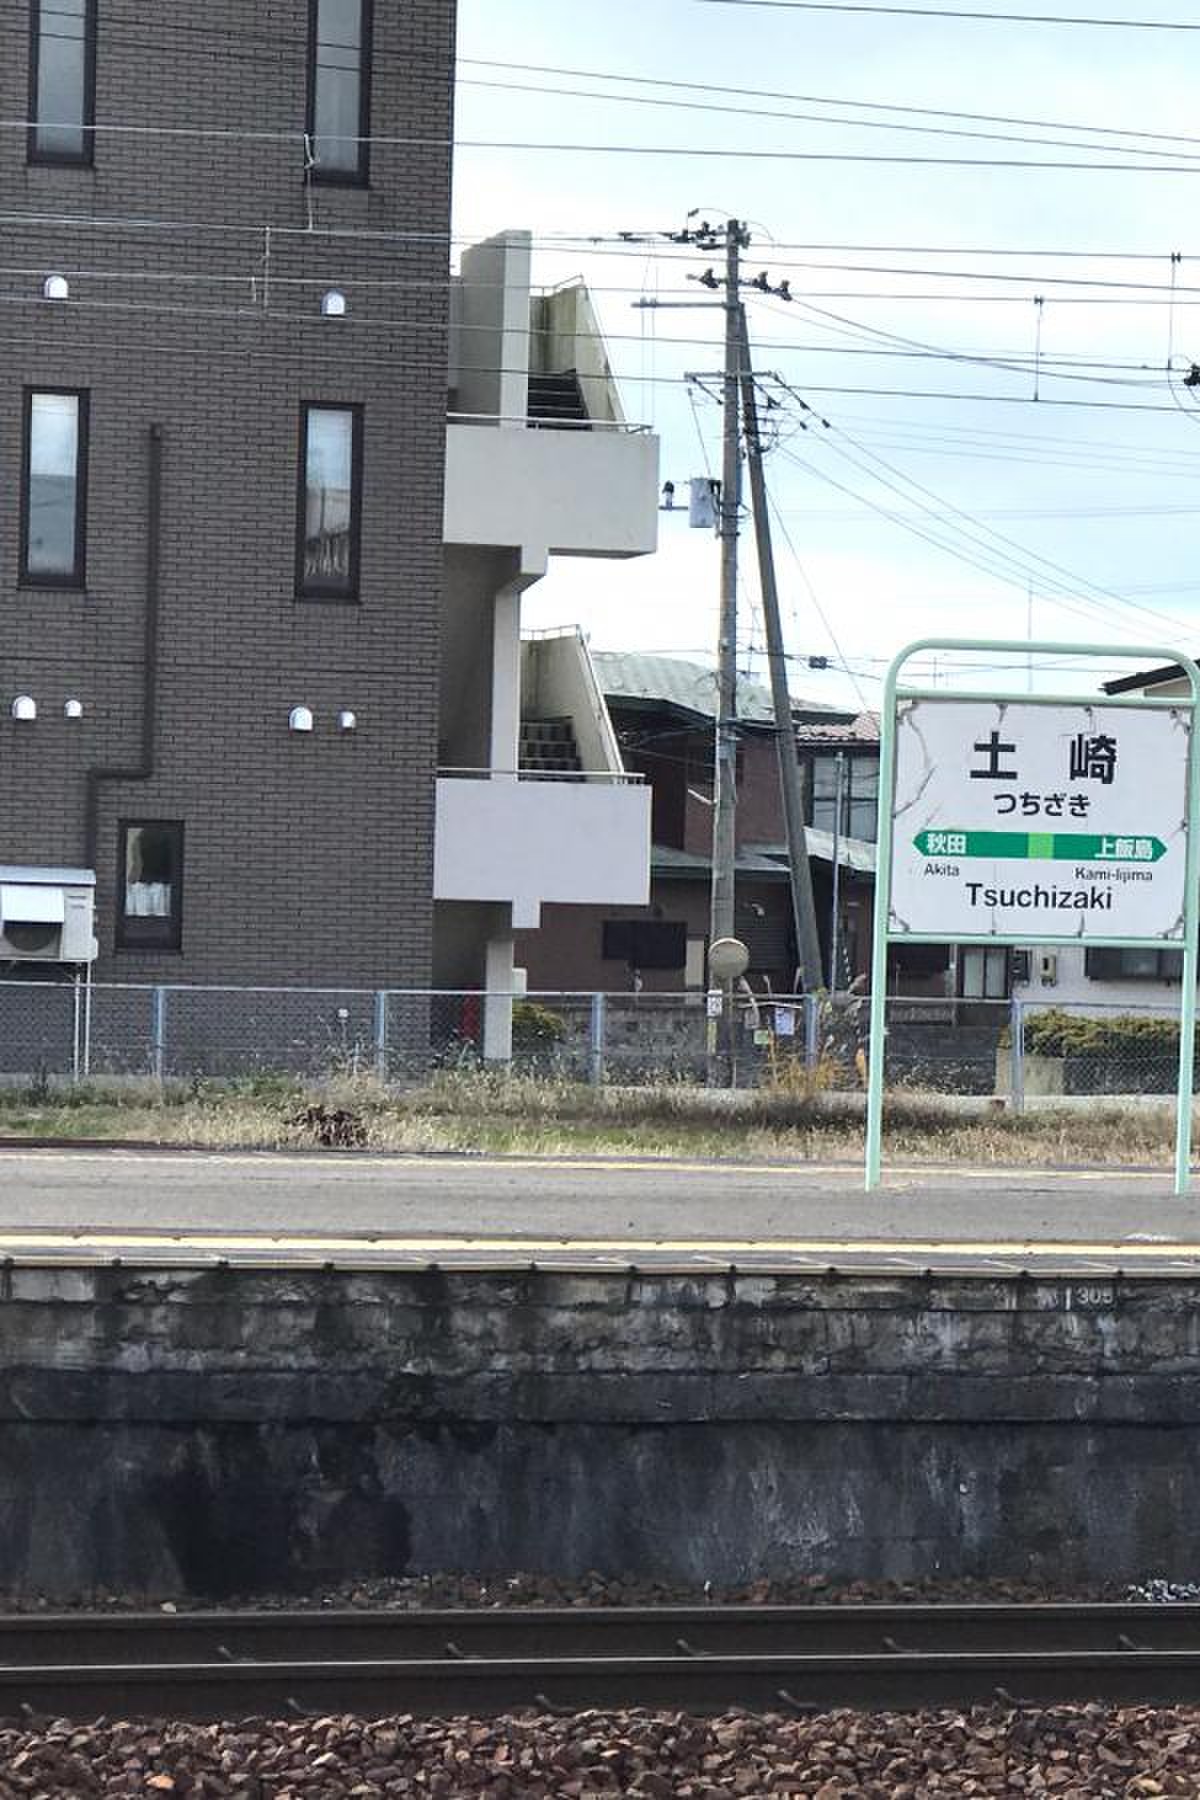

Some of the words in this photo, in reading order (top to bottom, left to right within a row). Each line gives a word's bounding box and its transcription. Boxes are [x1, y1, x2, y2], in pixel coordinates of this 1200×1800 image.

[994, 792, 1090, 817] つちざき
[927, 832, 967, 855] 秋田
[1094, 837, 1153, 859] 上飯島
[924, 863, 960, 877] Akita
[965, 882, 1112, 909] Tsuchizaki
